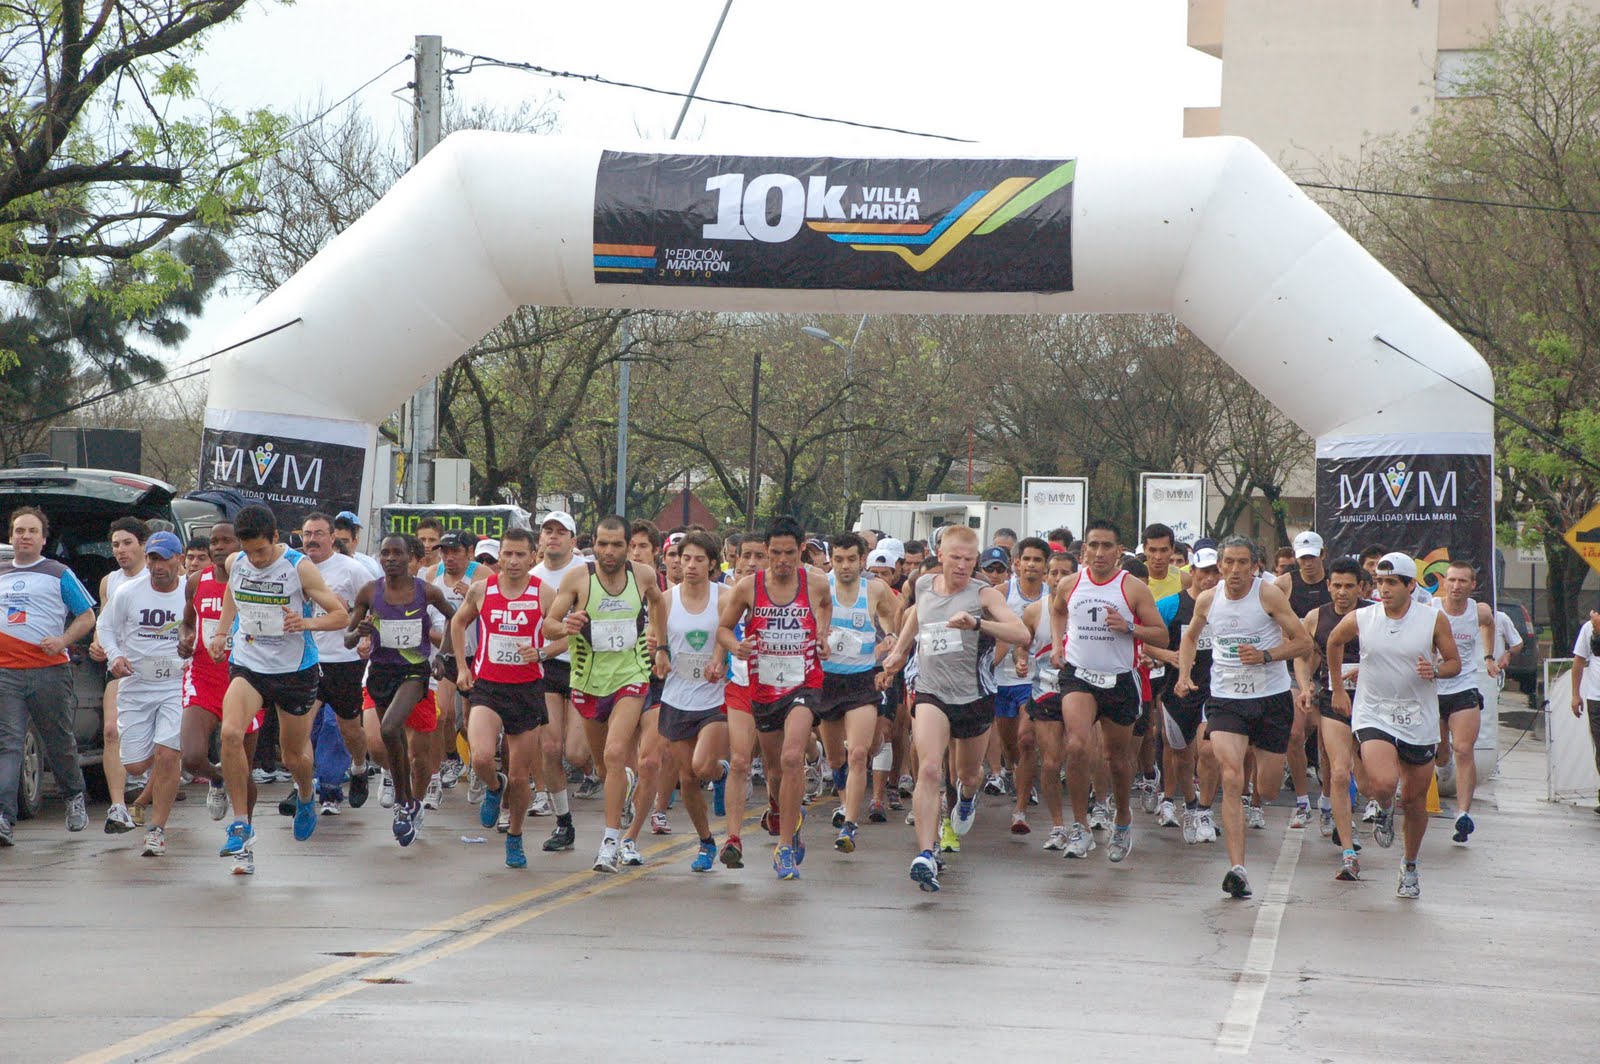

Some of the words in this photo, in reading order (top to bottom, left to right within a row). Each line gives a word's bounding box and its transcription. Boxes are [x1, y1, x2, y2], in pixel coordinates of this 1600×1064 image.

[862, 186, 921, 203] VILLA
[702, 173, 848, 243] 10k
[851, 199, 920, 220] MARÍA
[666, 259, 731, 272] MARATÓN
[659, 269, 712, 278] 2010
[214, 445, 323, 493] MVM
[1340, 467, 1457, 509] MVM
[267, 493, 291, 503] VILLA
[292, 495, 318, 506] MARIA
[1340, 513, 1403, 522] MUNICIPALIDAD
[1405, 513, 1431, 521] VILLA
[1432, 513, 1457, 521] MARIA
[201, 597, 224, 613] FIL
[491, 609, 529, 625] FILA
[755, 607, 789, 617] DUMAS
[791, 607, 808, 617] CAT
[767, 617, 801, 630] FILA
[395, 635, 410, 646] 12
[608, 635, 624, 648] 13
[837, 641, 844, 652] 6
[932, 638, 948, 651] 23
[497, 650, 521, 663] 256
[155, 668, 171, 679] 54
[693, 668, 700, 679] 8
[776, 672, 784, 683] 4
[1233, 682, 1256, 694] 221
[1390, 713, 1412, 725] 195
